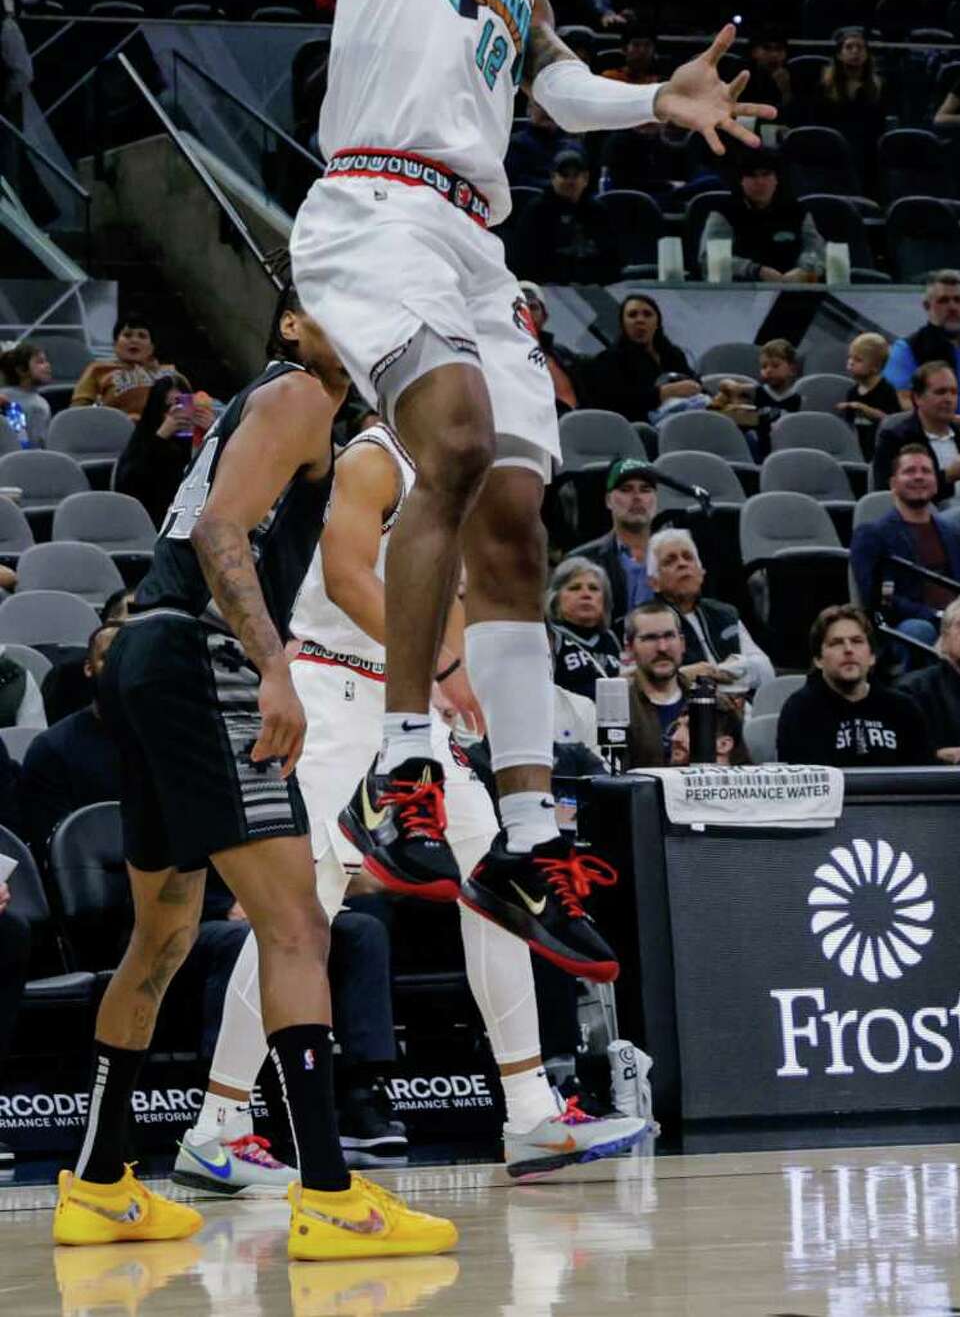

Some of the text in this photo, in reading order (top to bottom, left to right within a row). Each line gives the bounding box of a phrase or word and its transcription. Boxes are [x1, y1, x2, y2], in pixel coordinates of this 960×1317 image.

[475, 18, 508, 92] 12
[159, 436, 219, 540] 4
[685, 784, 831, 802] PERFORMANCE WATER
[453, 1096, 493, 1108] WATER
